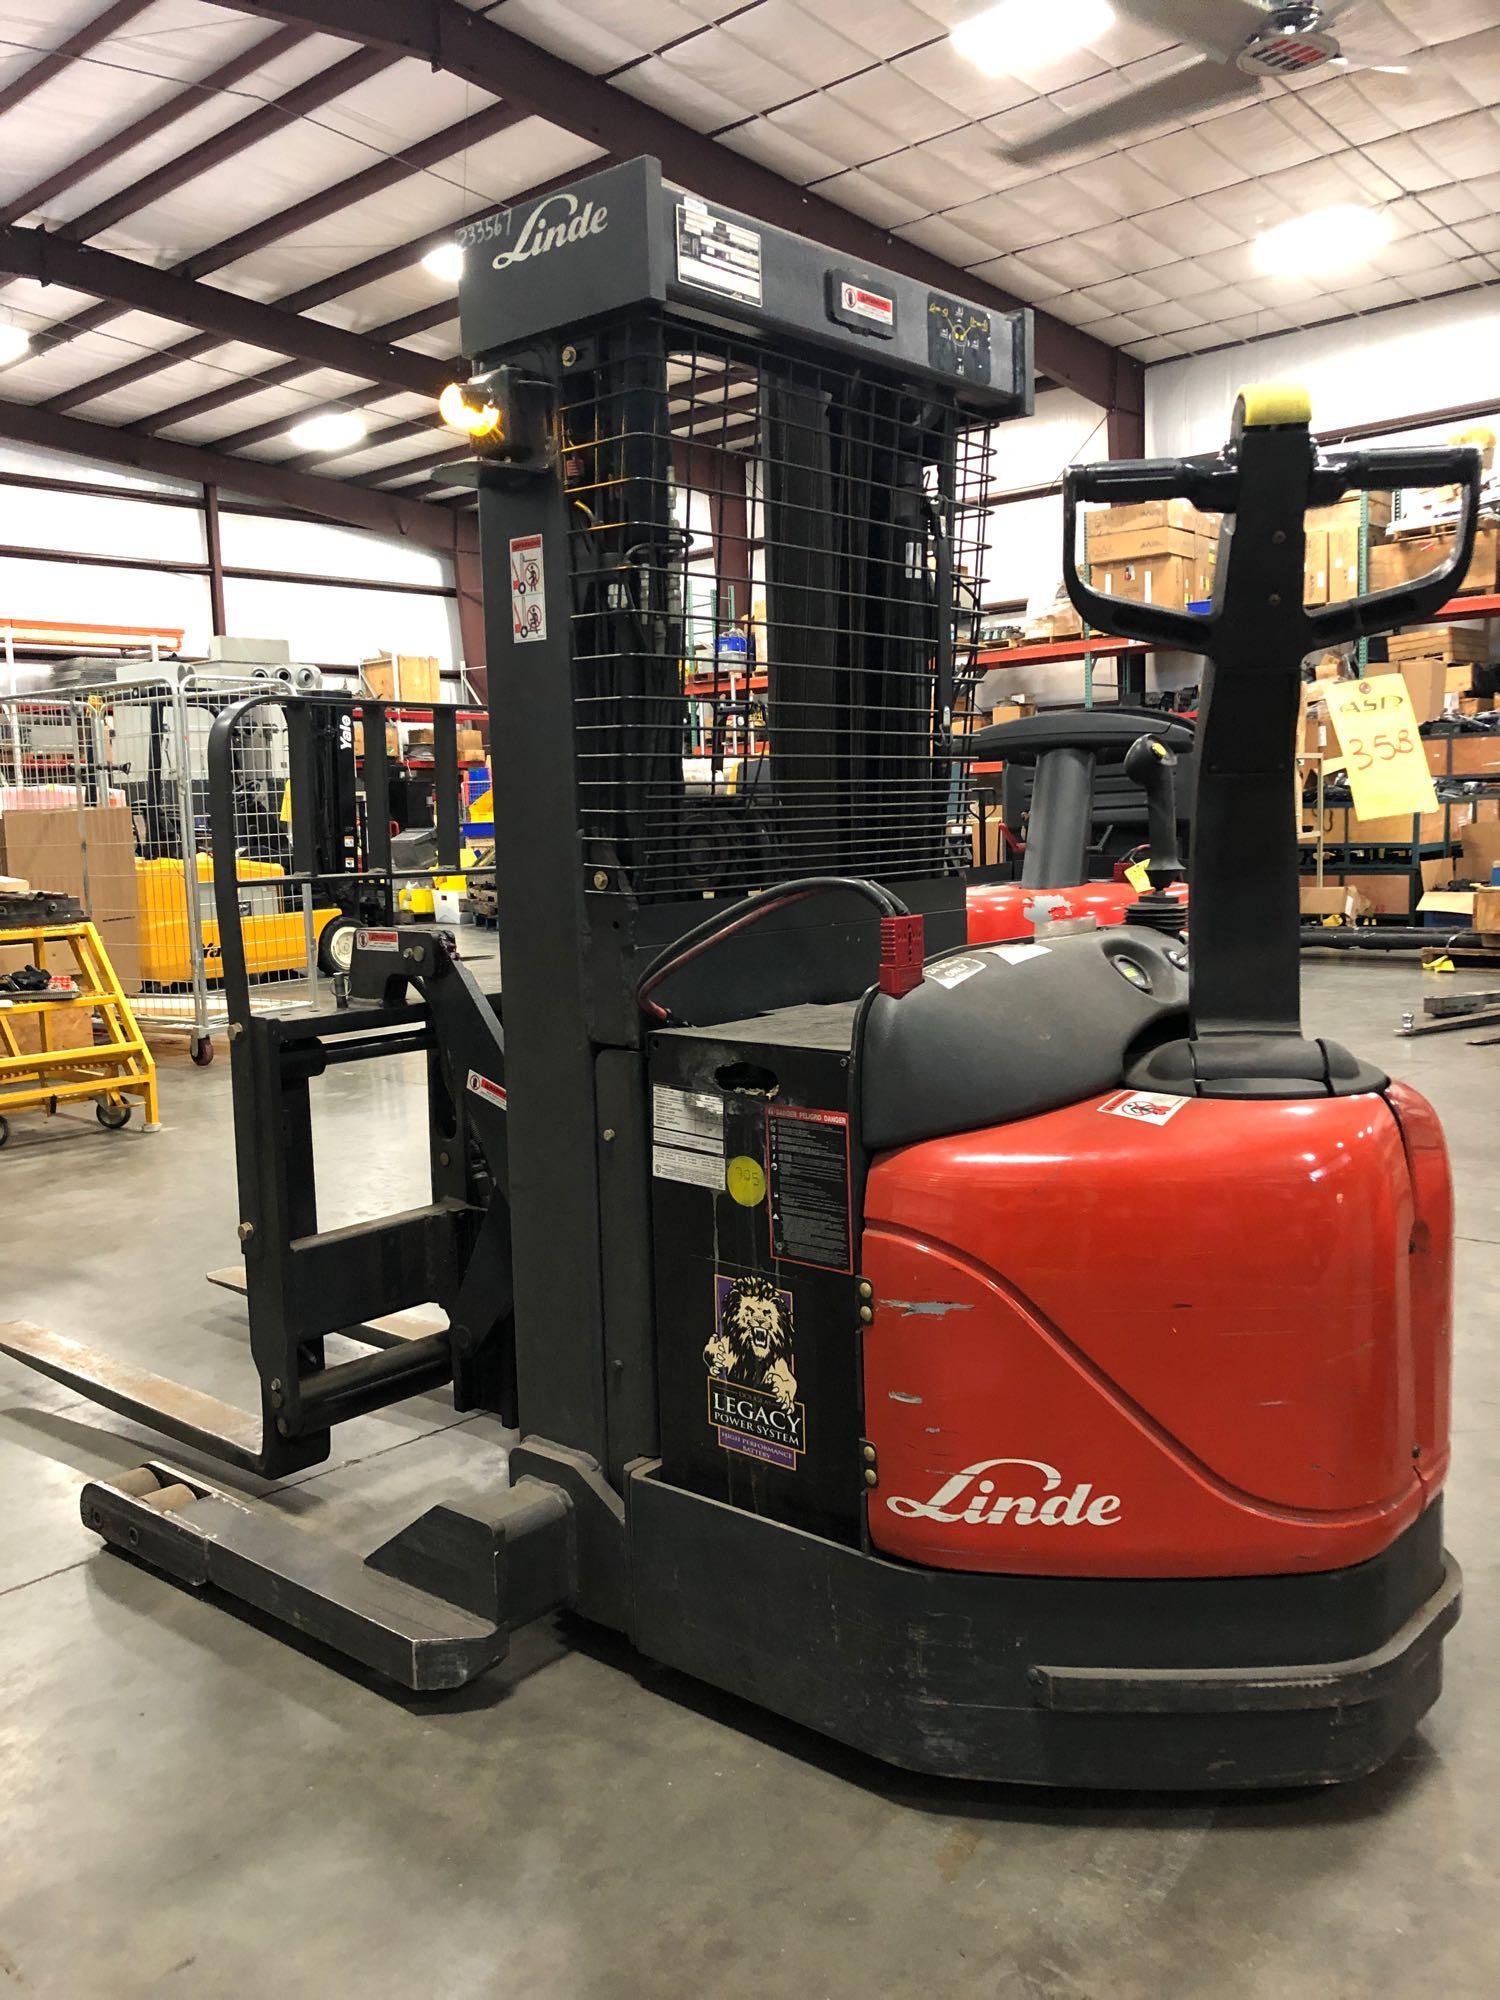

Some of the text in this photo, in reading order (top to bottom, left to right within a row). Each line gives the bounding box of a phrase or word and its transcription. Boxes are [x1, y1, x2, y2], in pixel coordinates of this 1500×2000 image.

[492, 193, 608, 270] Linde
[339, 714, 352, 750] Yale
[1348, 729, 1414, 771] 358
[799, 1111, 822, 1121] PELIGRO
[823, 1115, 847, 1124] DANGER
[713, 1392, 801, 1434] LEGACY
[714, 1411, 799, 1447] POWER SYSTEM
[721, 1431, 792, 1460] HIGH PERFORMANCE
[742, 1445, 771, 1459] BATTERY
[886, 1458, 1122, 1527] Linde
